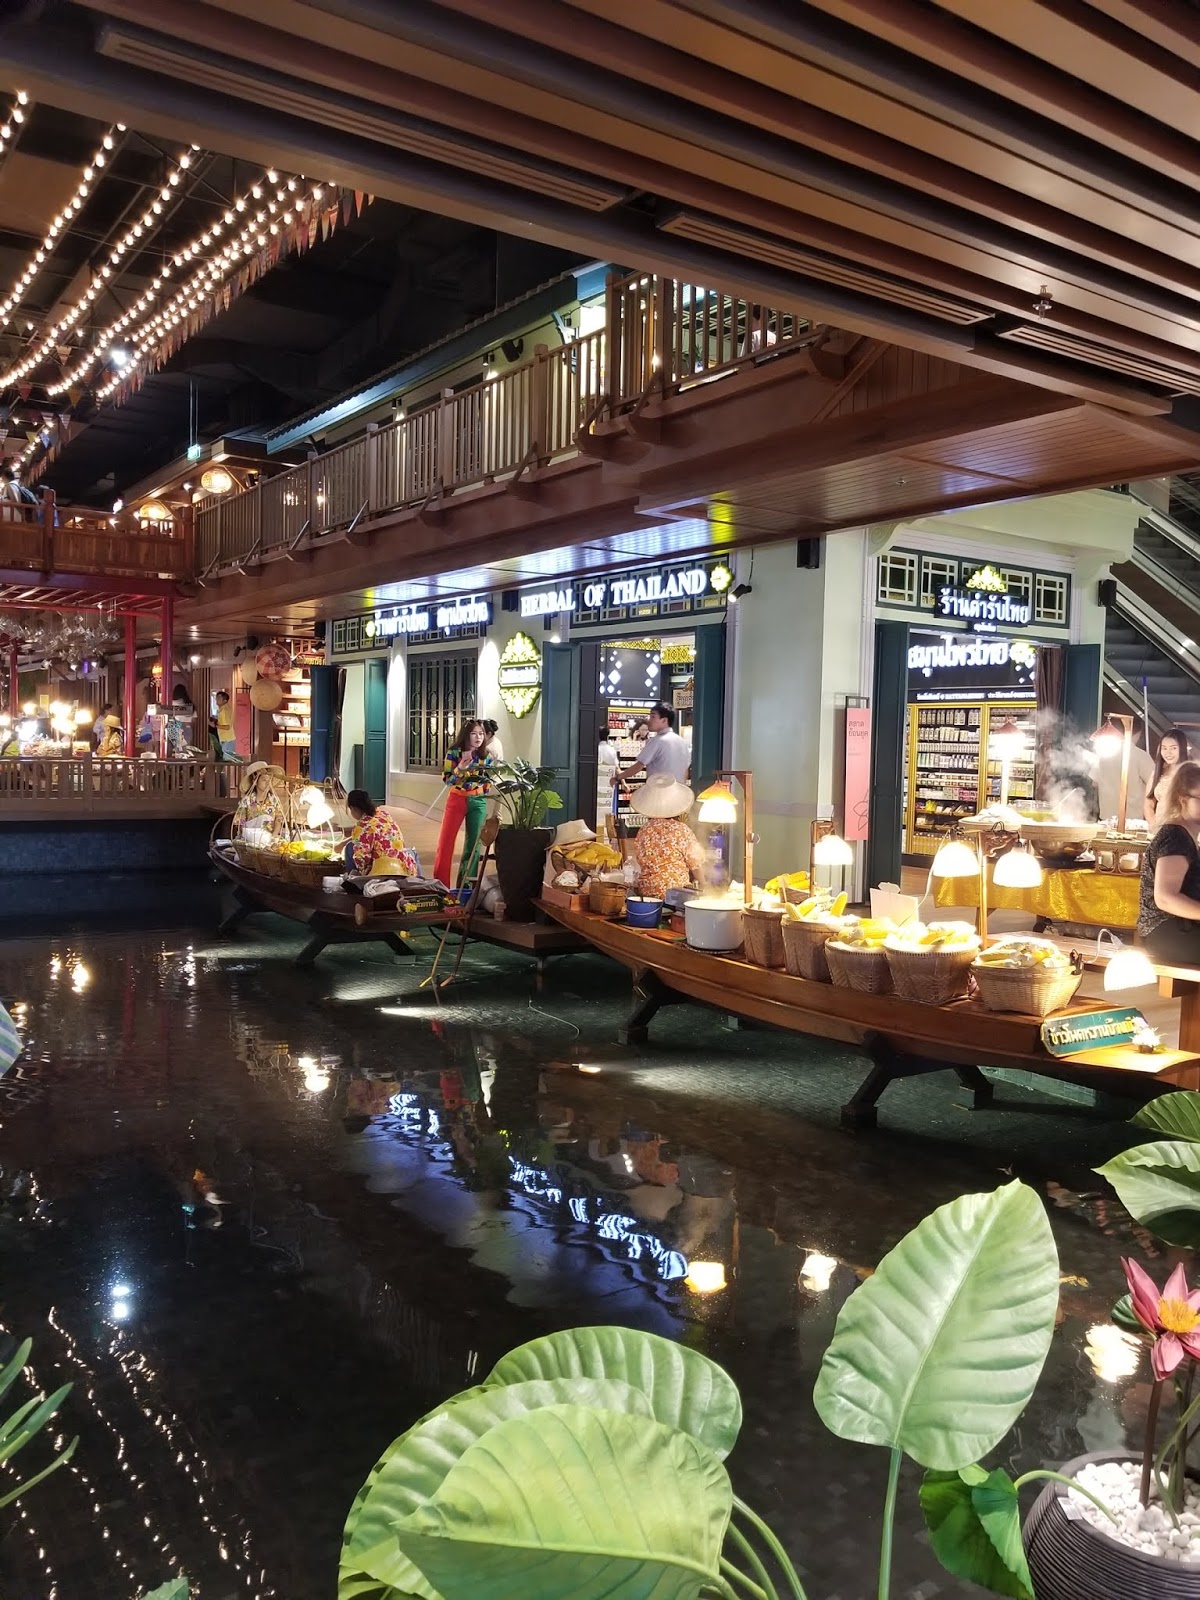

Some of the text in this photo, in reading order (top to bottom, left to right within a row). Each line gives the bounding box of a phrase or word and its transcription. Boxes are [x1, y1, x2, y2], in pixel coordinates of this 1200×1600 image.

[521, 569, 707, 617] HERBAL OF THAILAND
[940, 587, 1030, 624] ร้านตำรับไทย
[907, 634, 1009, 678] สมุนไพรไทย
